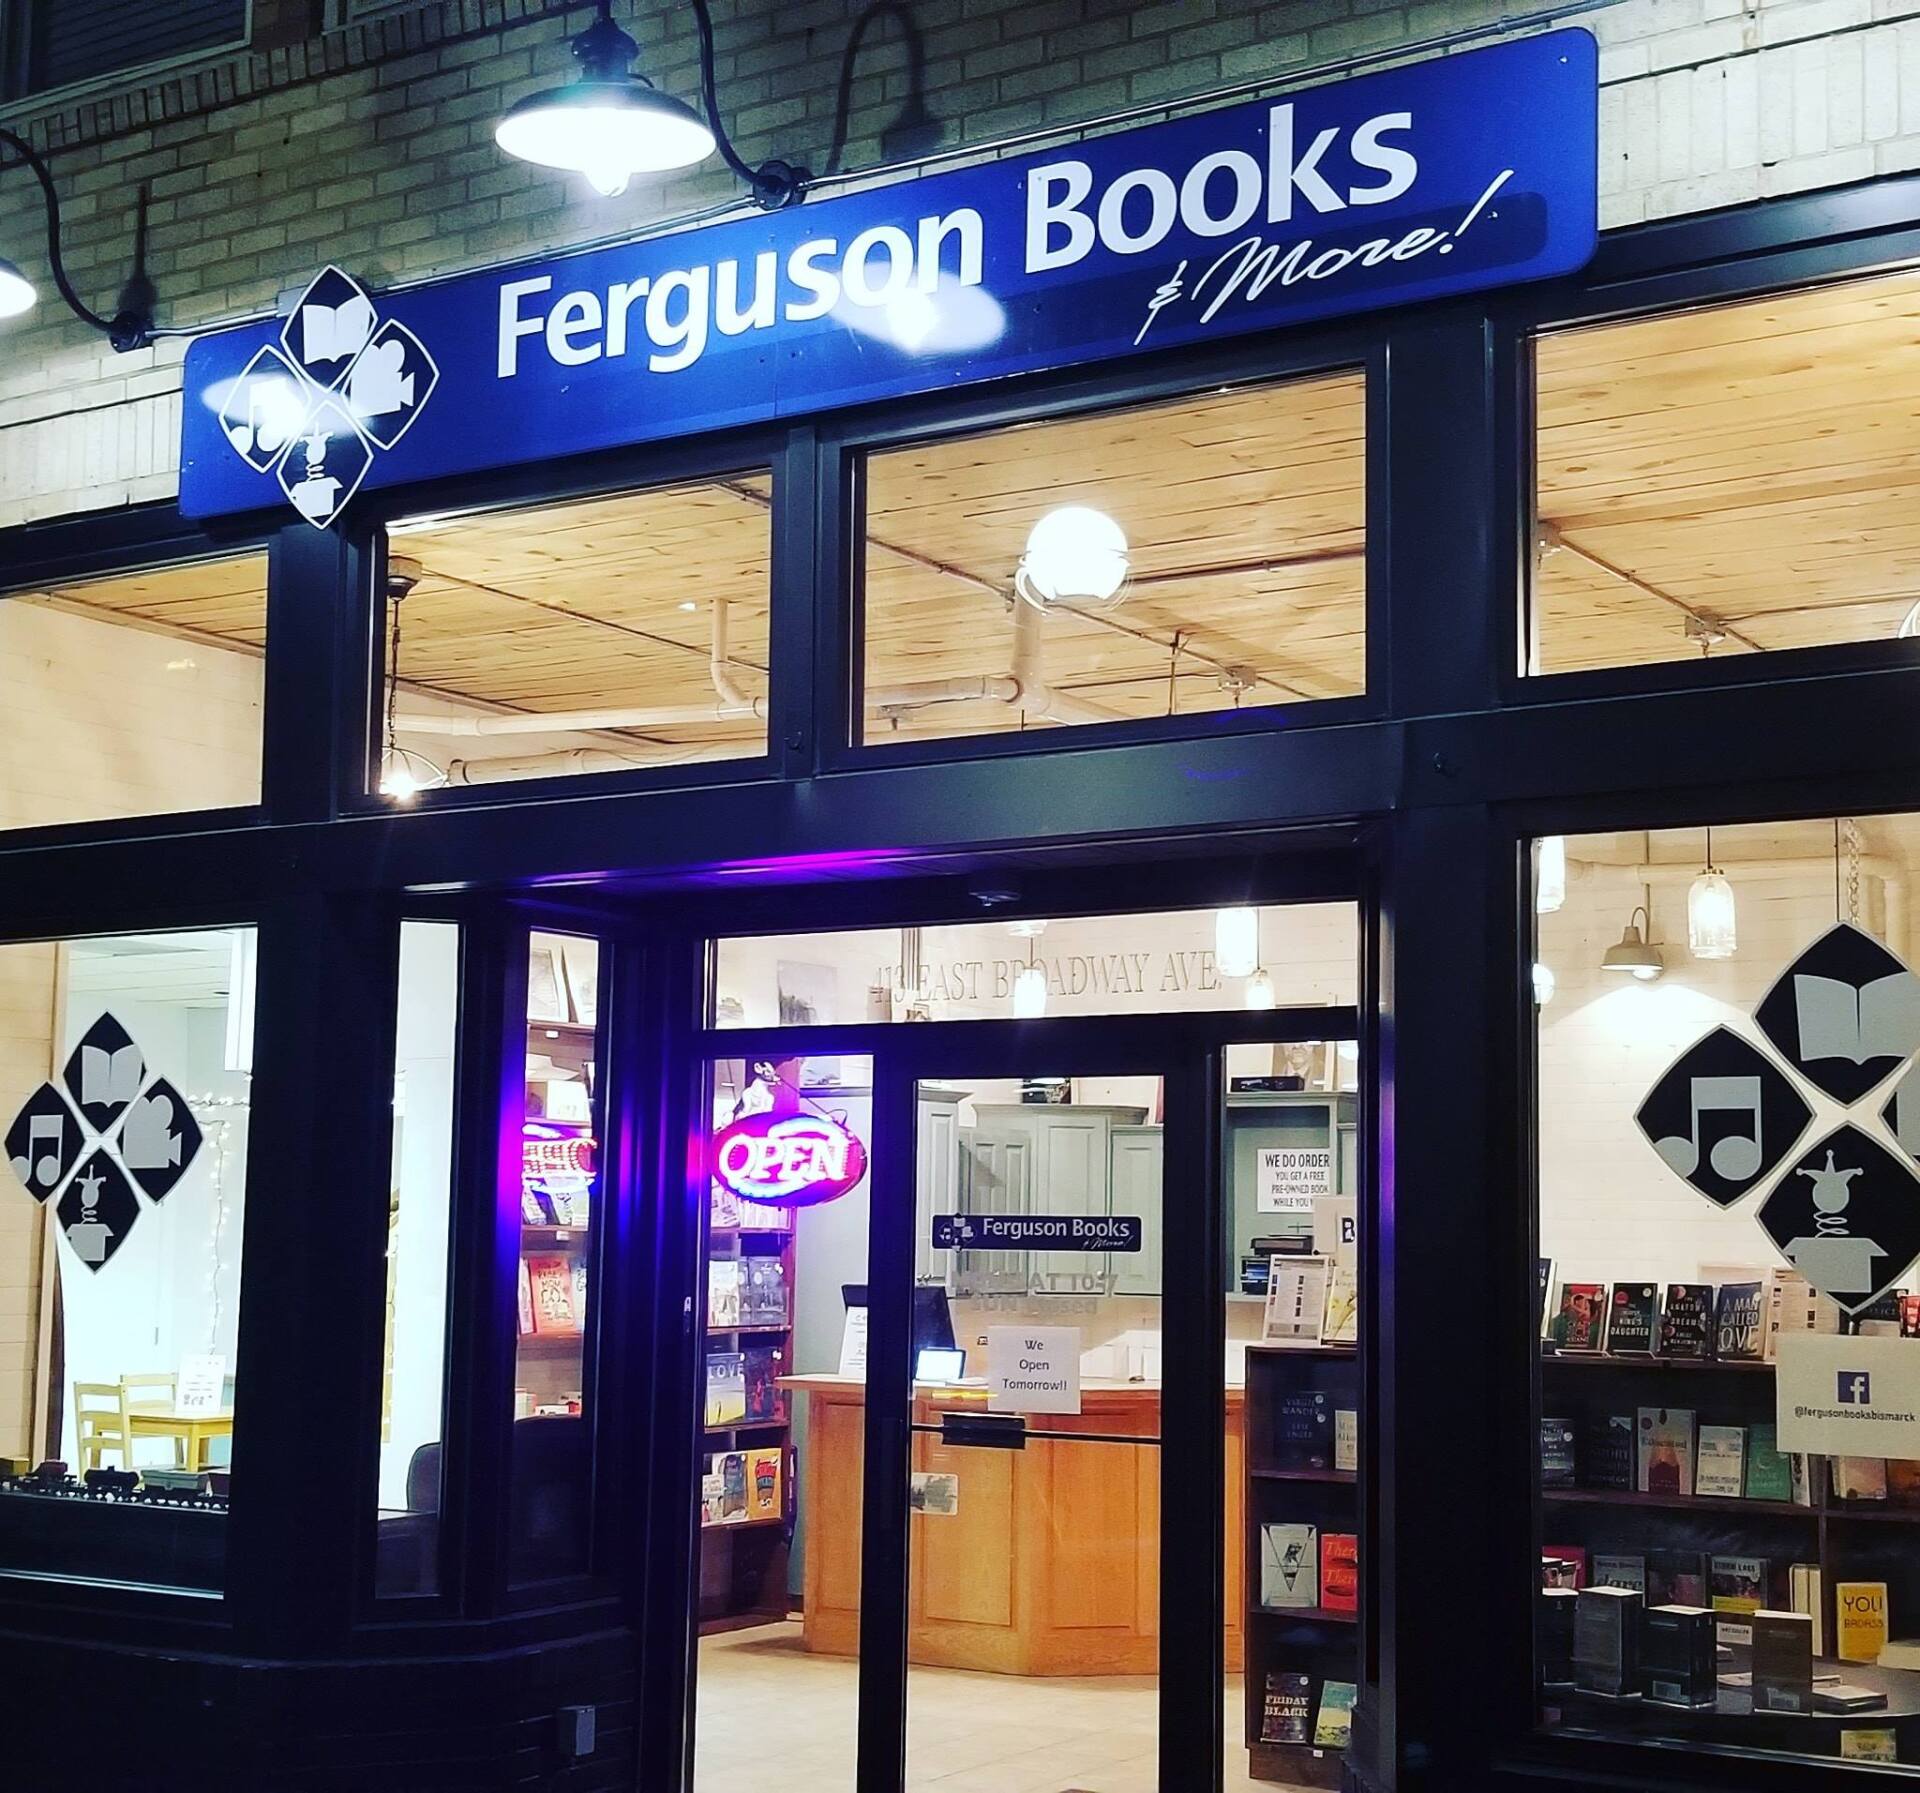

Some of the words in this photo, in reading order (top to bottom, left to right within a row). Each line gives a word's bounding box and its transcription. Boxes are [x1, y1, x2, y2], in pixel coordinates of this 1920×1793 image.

[497, 208, 984, 379] Ferguson
[1023, 103, 1418, 274] Books
[1191, 169, 1514, 324] More!
[915, 961, 982, 1002] EAST
[1160, 950, 1222, 993] AVE.
[718, 1134, 850, 1182] OPEN
[1265, 1154, 1280, 1167] WE
[1282, 1154, 1296, 1167] DO
[1298, 1154, 1330, 1168] ORDER
[1275, 1171, 1288, 1180] YOU
[1290, 1171, 1302, 1180] GET
[1303, 1171, 1308, 1180] A
[1309, 1171, 1325, 1180] FREE
[1271, 1184, 1309, 1194] PRE-OWNED
[1311, 1184, 1329, 1194] BOOK
[983, 1218, 1067, 1239] Ferguson
[1072, 1218, 1130, 1238] Books
[1734, 1297, 1759, 1312] MAN
[1610, 1326, 1649, 1336] DAUGHTER
[1025, 1340, 1044, 1350] We
[1720, 1325, 1760, 1352] OVE
[1019, 1359, 1050, 1372] Open
[1002, 1378, 1067, 1391] Tomorrow!!
[1794, 1406, 1916, 1422] @fergusonbooksbismarck
[1844, 1595, 1882, 1613] YOU
[1844, 1617, 1883, 1629] BADASS
[1265, 1695, 1309, 1705] FRIDAY
[1264, 1705, 1308, 1717] BLACK
